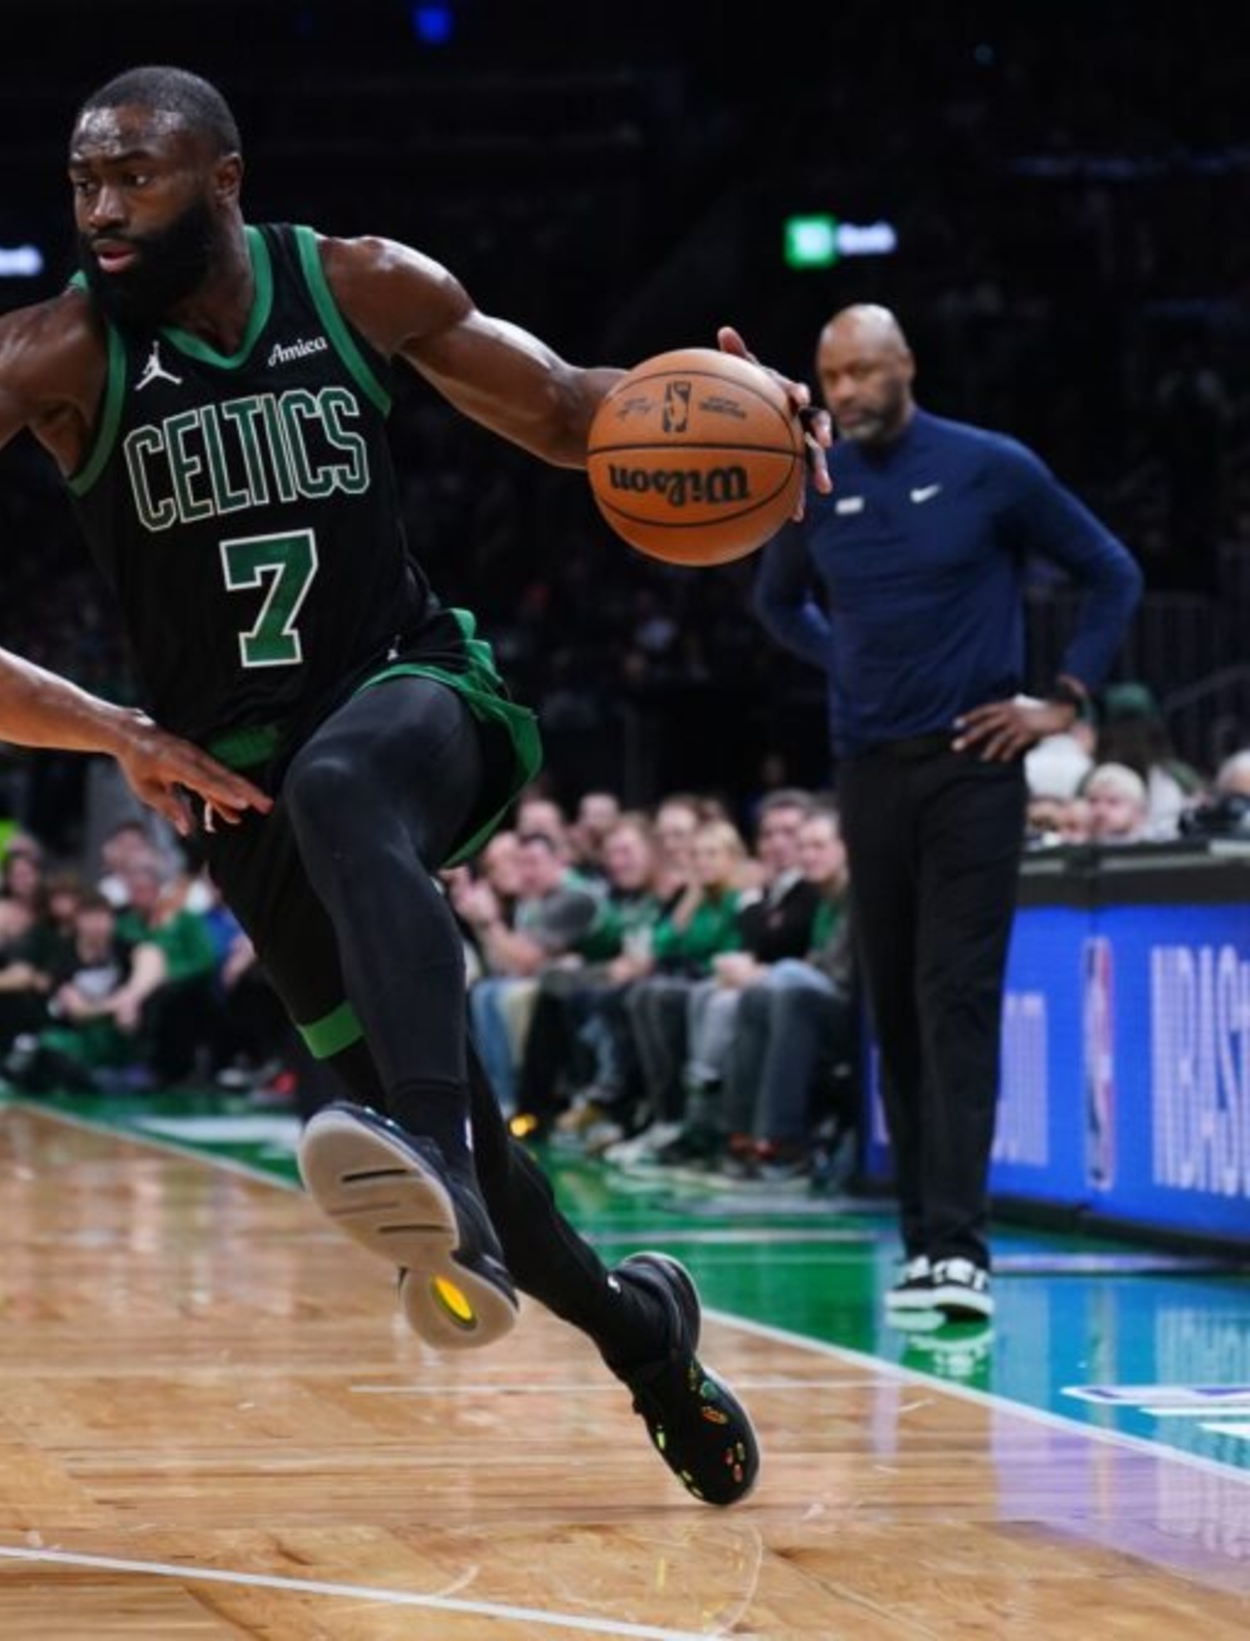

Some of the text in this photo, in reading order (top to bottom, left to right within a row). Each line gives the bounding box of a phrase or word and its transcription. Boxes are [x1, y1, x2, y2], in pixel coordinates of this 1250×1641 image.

[268, 336, 328, 367] Amica
[123, 387, 370, 531] CELTICS
[608, 463, 751, 507] Wilson
[219, 527, 319, 667] 7
